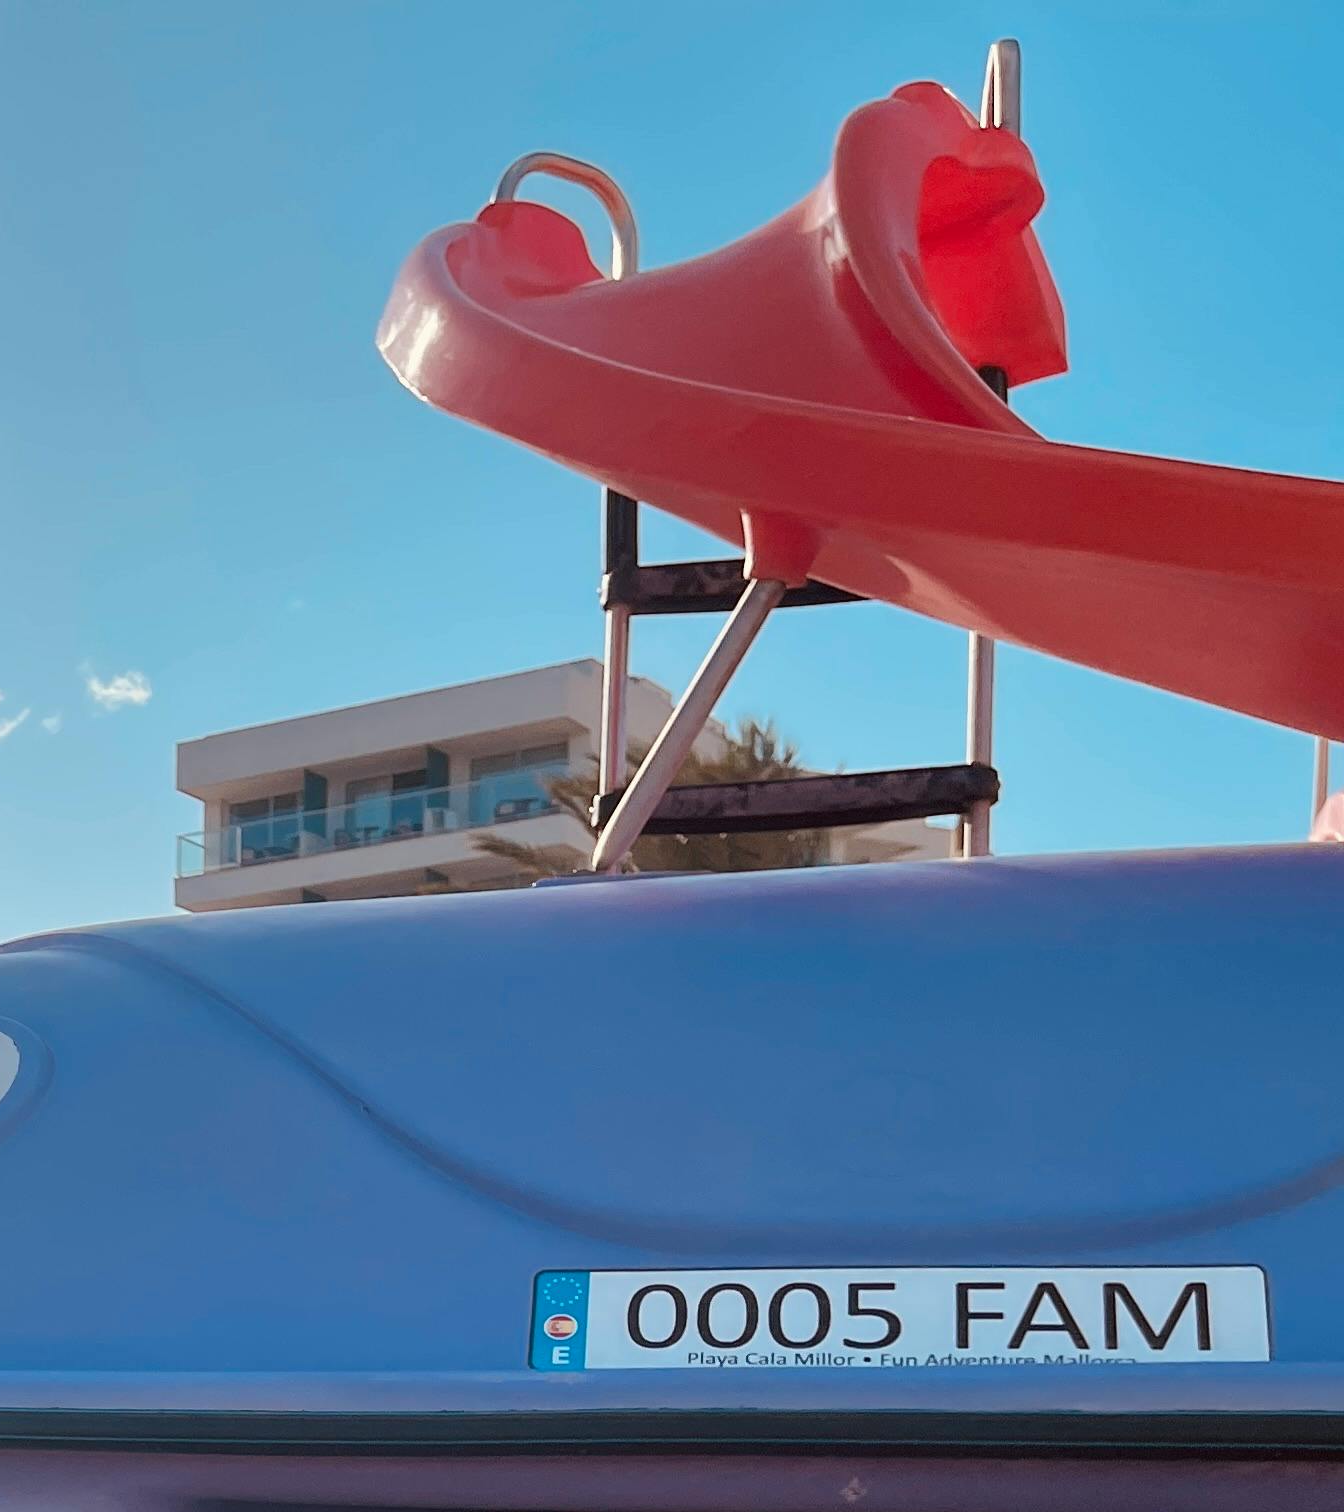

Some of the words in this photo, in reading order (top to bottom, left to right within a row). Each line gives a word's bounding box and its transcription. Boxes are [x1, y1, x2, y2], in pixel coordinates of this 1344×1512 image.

[627, 1281, 902, 1349] 0005
[956, 1282, 1212, 1350] FAM
[552, 1346, 570, 1365] E
[687, 1352, 738, 1368] Playa
[745, 1352, 787, 1366] Cala
[794, 1352, 855, 1366] Millor
[880, 1353, 917, 1367] Fun
[925, 1353, 1036, 1366] Adventure
